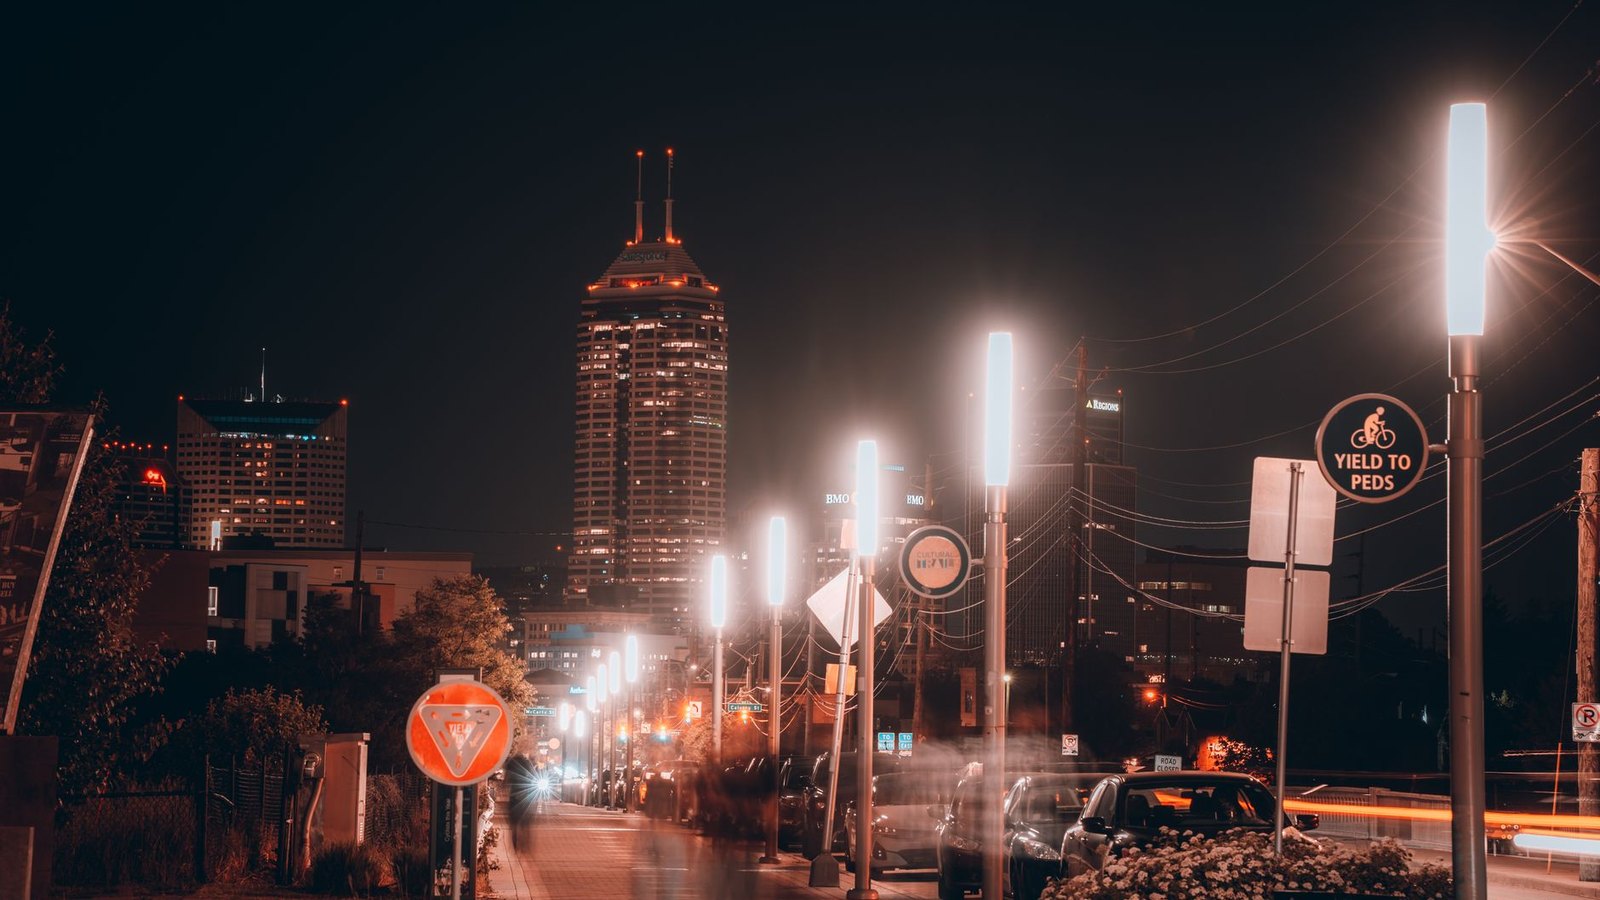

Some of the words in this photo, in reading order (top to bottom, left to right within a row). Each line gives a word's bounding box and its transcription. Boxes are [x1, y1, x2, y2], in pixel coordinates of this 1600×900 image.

[1334, 453, 1383, 469] YIELD
[1388, 454, 1411, 470] TO
[1351, 474, 1395, 490] PEDS
[826, 493, 849, 504] BMO
[906, 495, 924, 505] BMO
